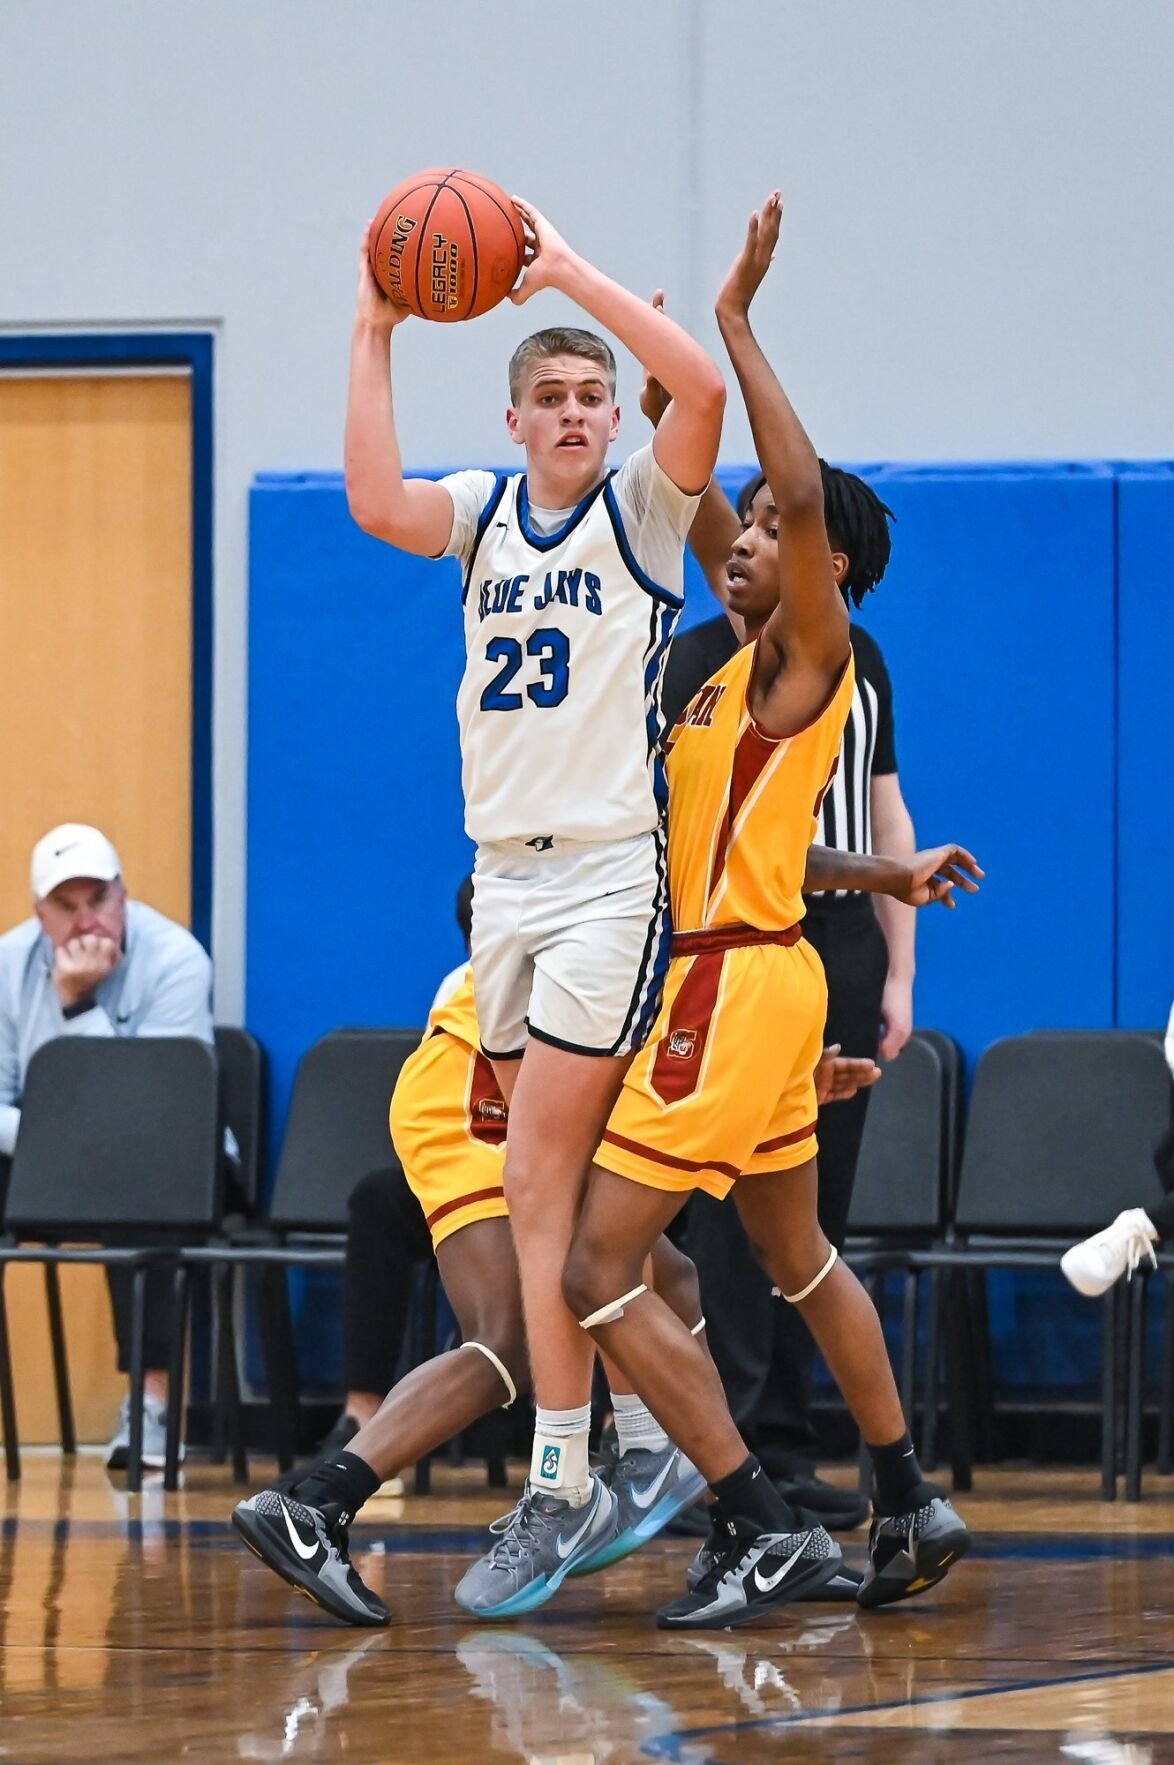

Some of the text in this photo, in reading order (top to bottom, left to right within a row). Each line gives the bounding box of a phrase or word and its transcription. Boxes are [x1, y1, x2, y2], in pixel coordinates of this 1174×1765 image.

[388, 214, 418, 304] PALDING
[431, 233, 448, 313] LEGACY
[533, 567, 603, 616] JAYS
[480, 627, 571, 712] 23
